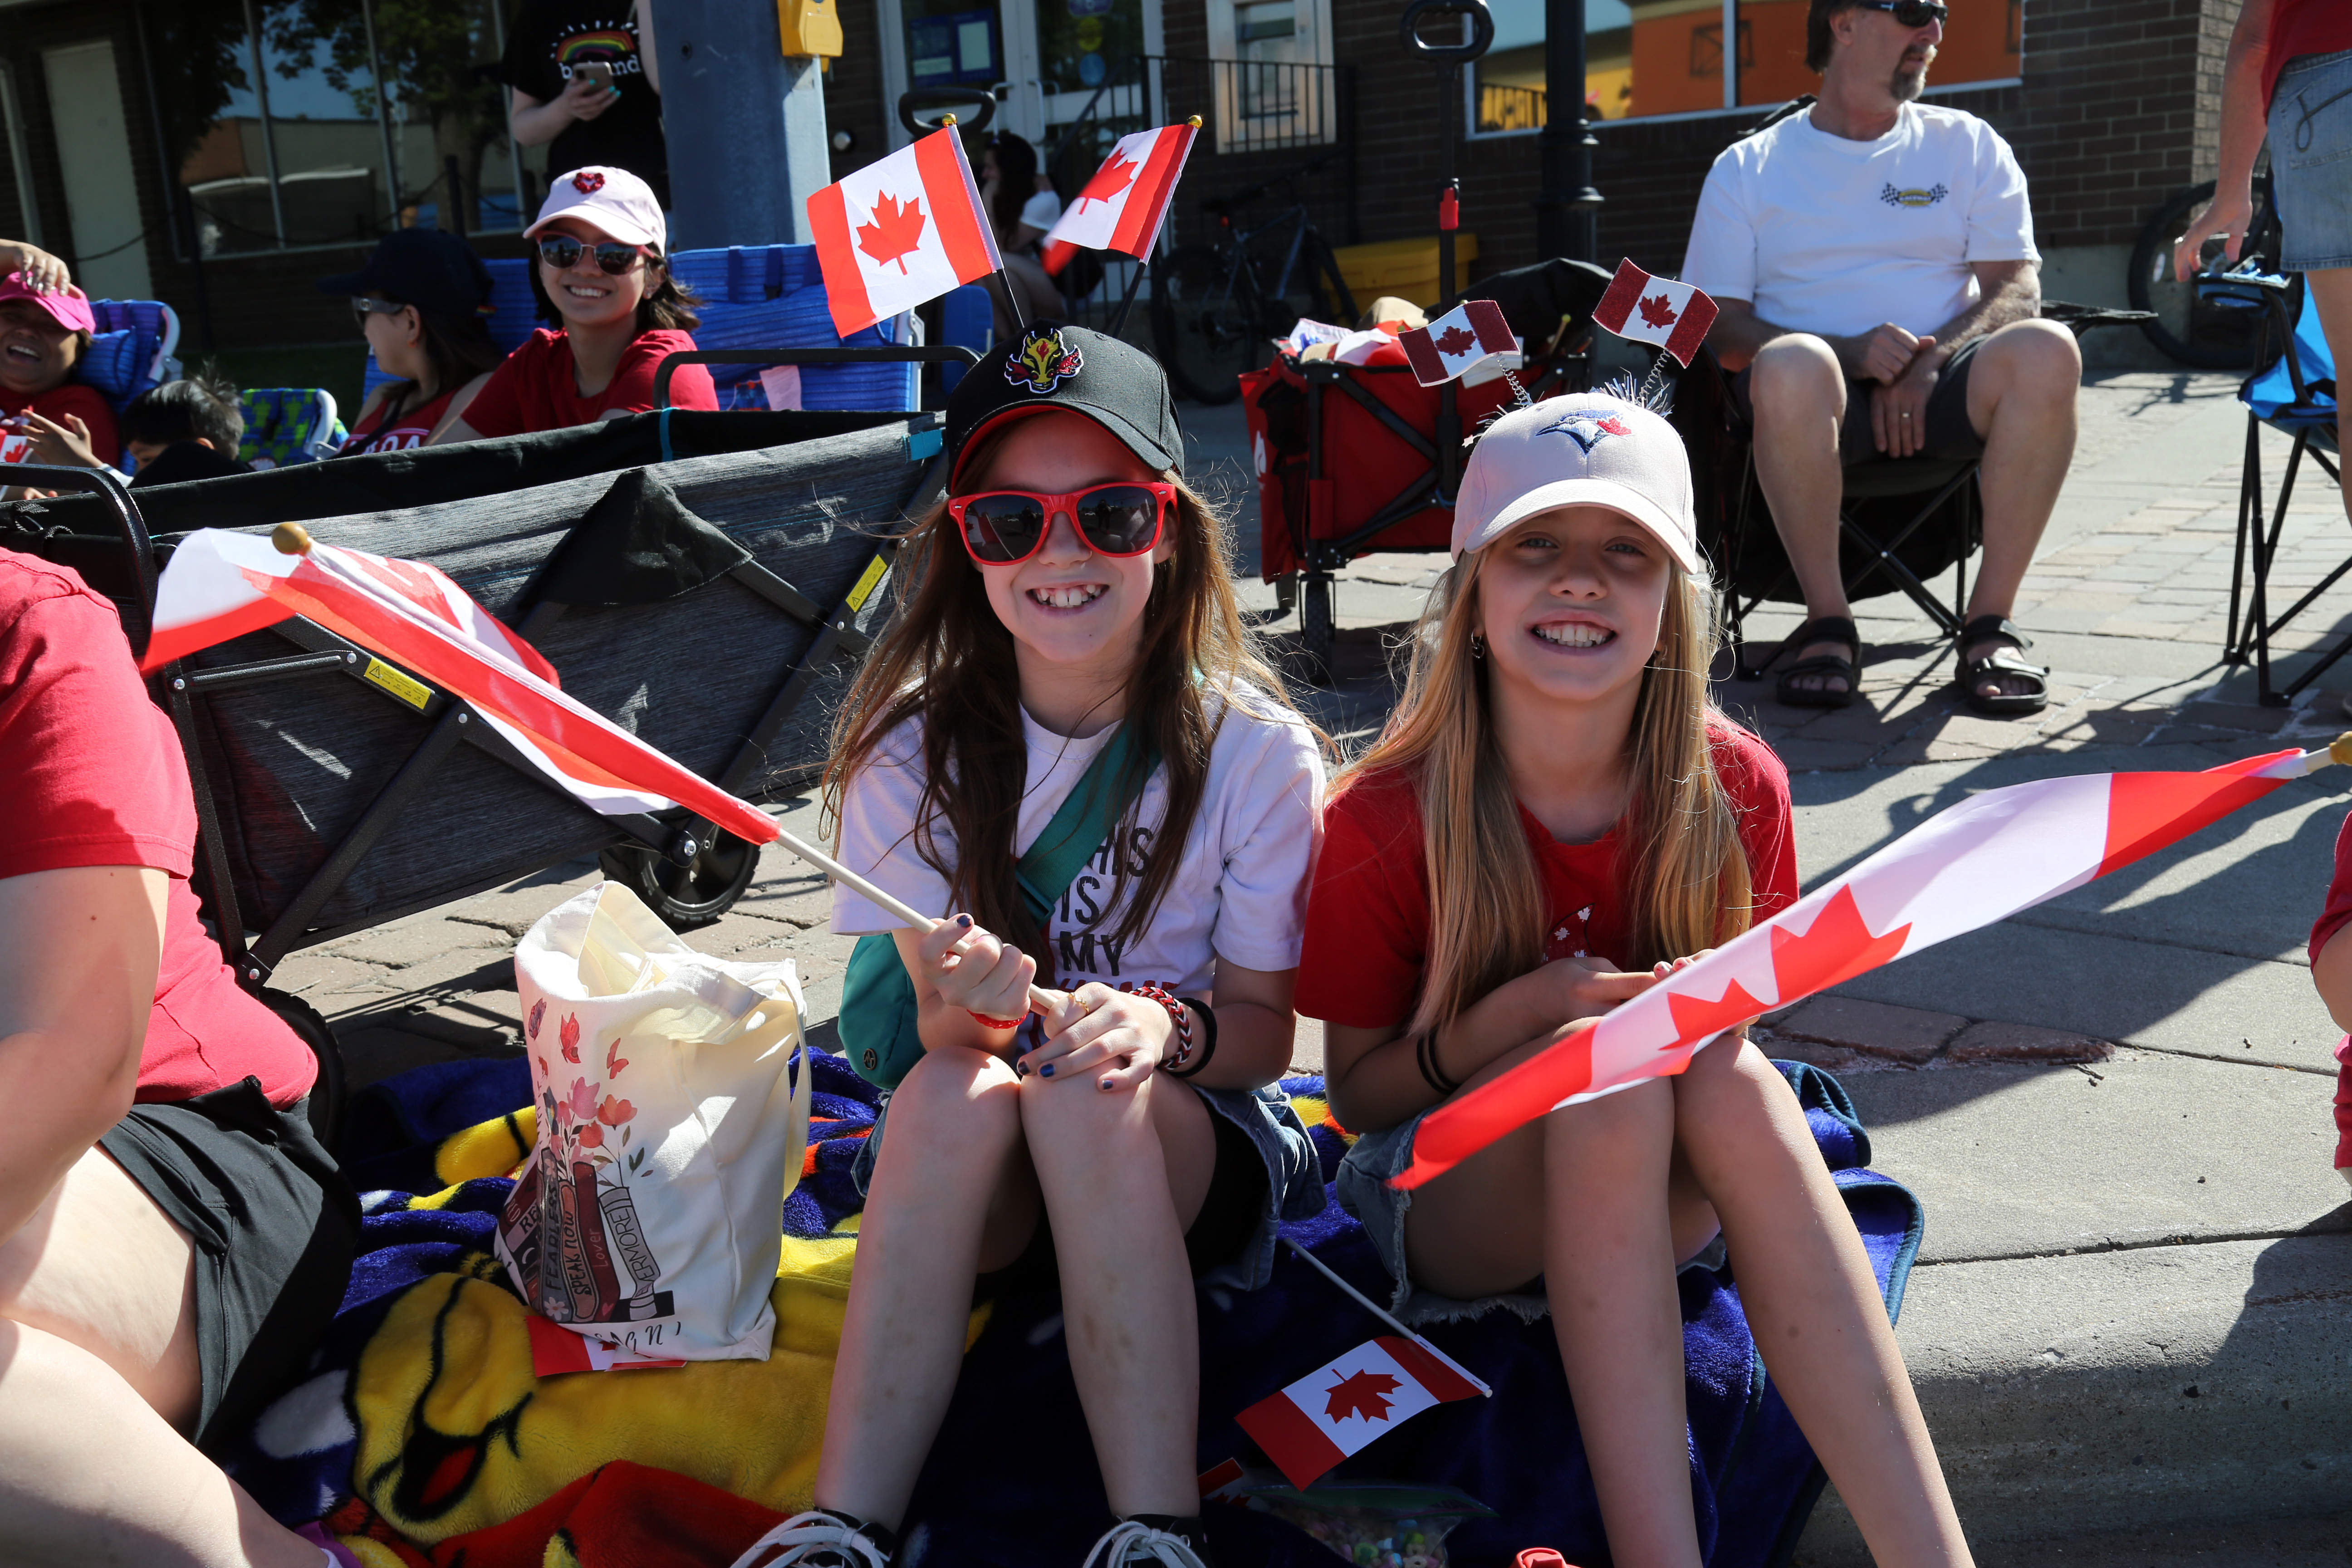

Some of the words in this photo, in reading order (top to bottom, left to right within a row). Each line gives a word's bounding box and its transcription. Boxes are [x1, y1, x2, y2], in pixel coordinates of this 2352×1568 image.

[1088, 826, 1153, 878] HIS
[1060, 876, 1101, 925] IS
[1059, 931, 1128, 976] MY
[506, 1198, 521, 1222] RED
[545, 1184, 562, 1291] FEARLESS
[589, 1228, 608, 1267] Lover
[564, 1253, 593, 1296] SPEAK
